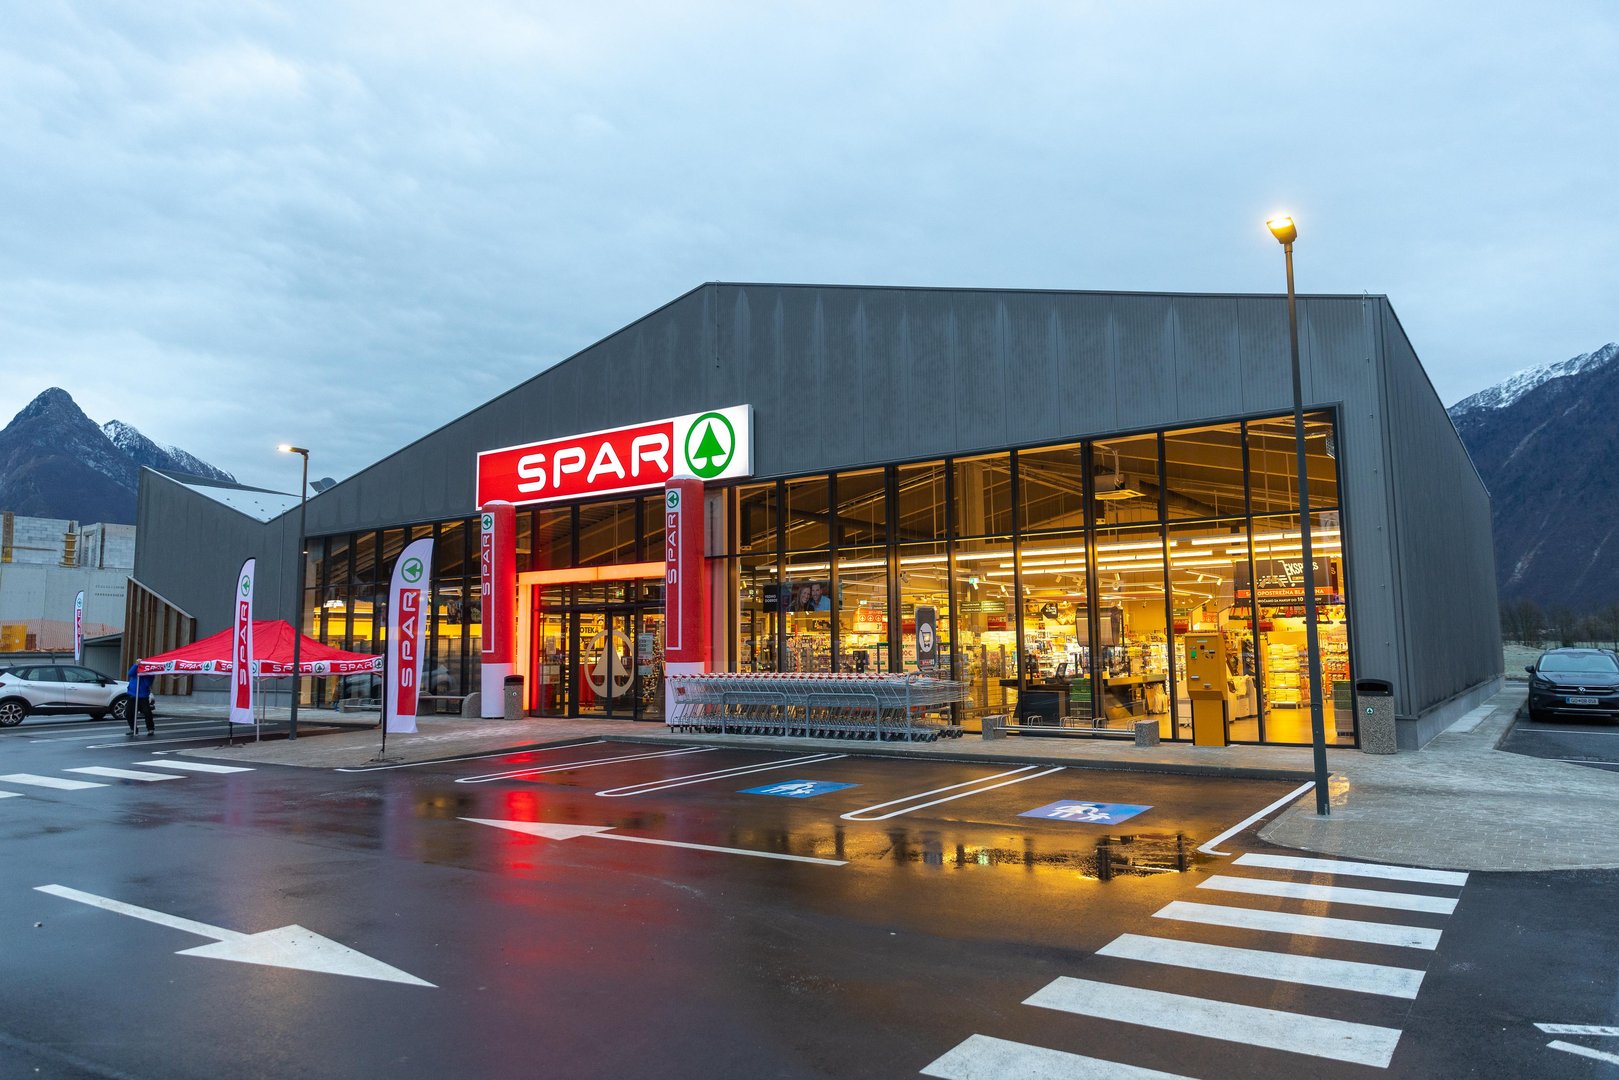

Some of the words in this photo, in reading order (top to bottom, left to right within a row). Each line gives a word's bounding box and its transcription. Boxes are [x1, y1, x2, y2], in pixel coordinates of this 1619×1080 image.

[517, 432, 670, 493] SPAR
[482, 534, 491, 596] SPAR
[668, 513, 677, 585] SPAR
[1285, 562, 1319, 575] EKSPS
[239, 603, 248, 686] SPAR
[339, 661, 373, 671] SPAR
[402, 591, 417, 688] SPAR
